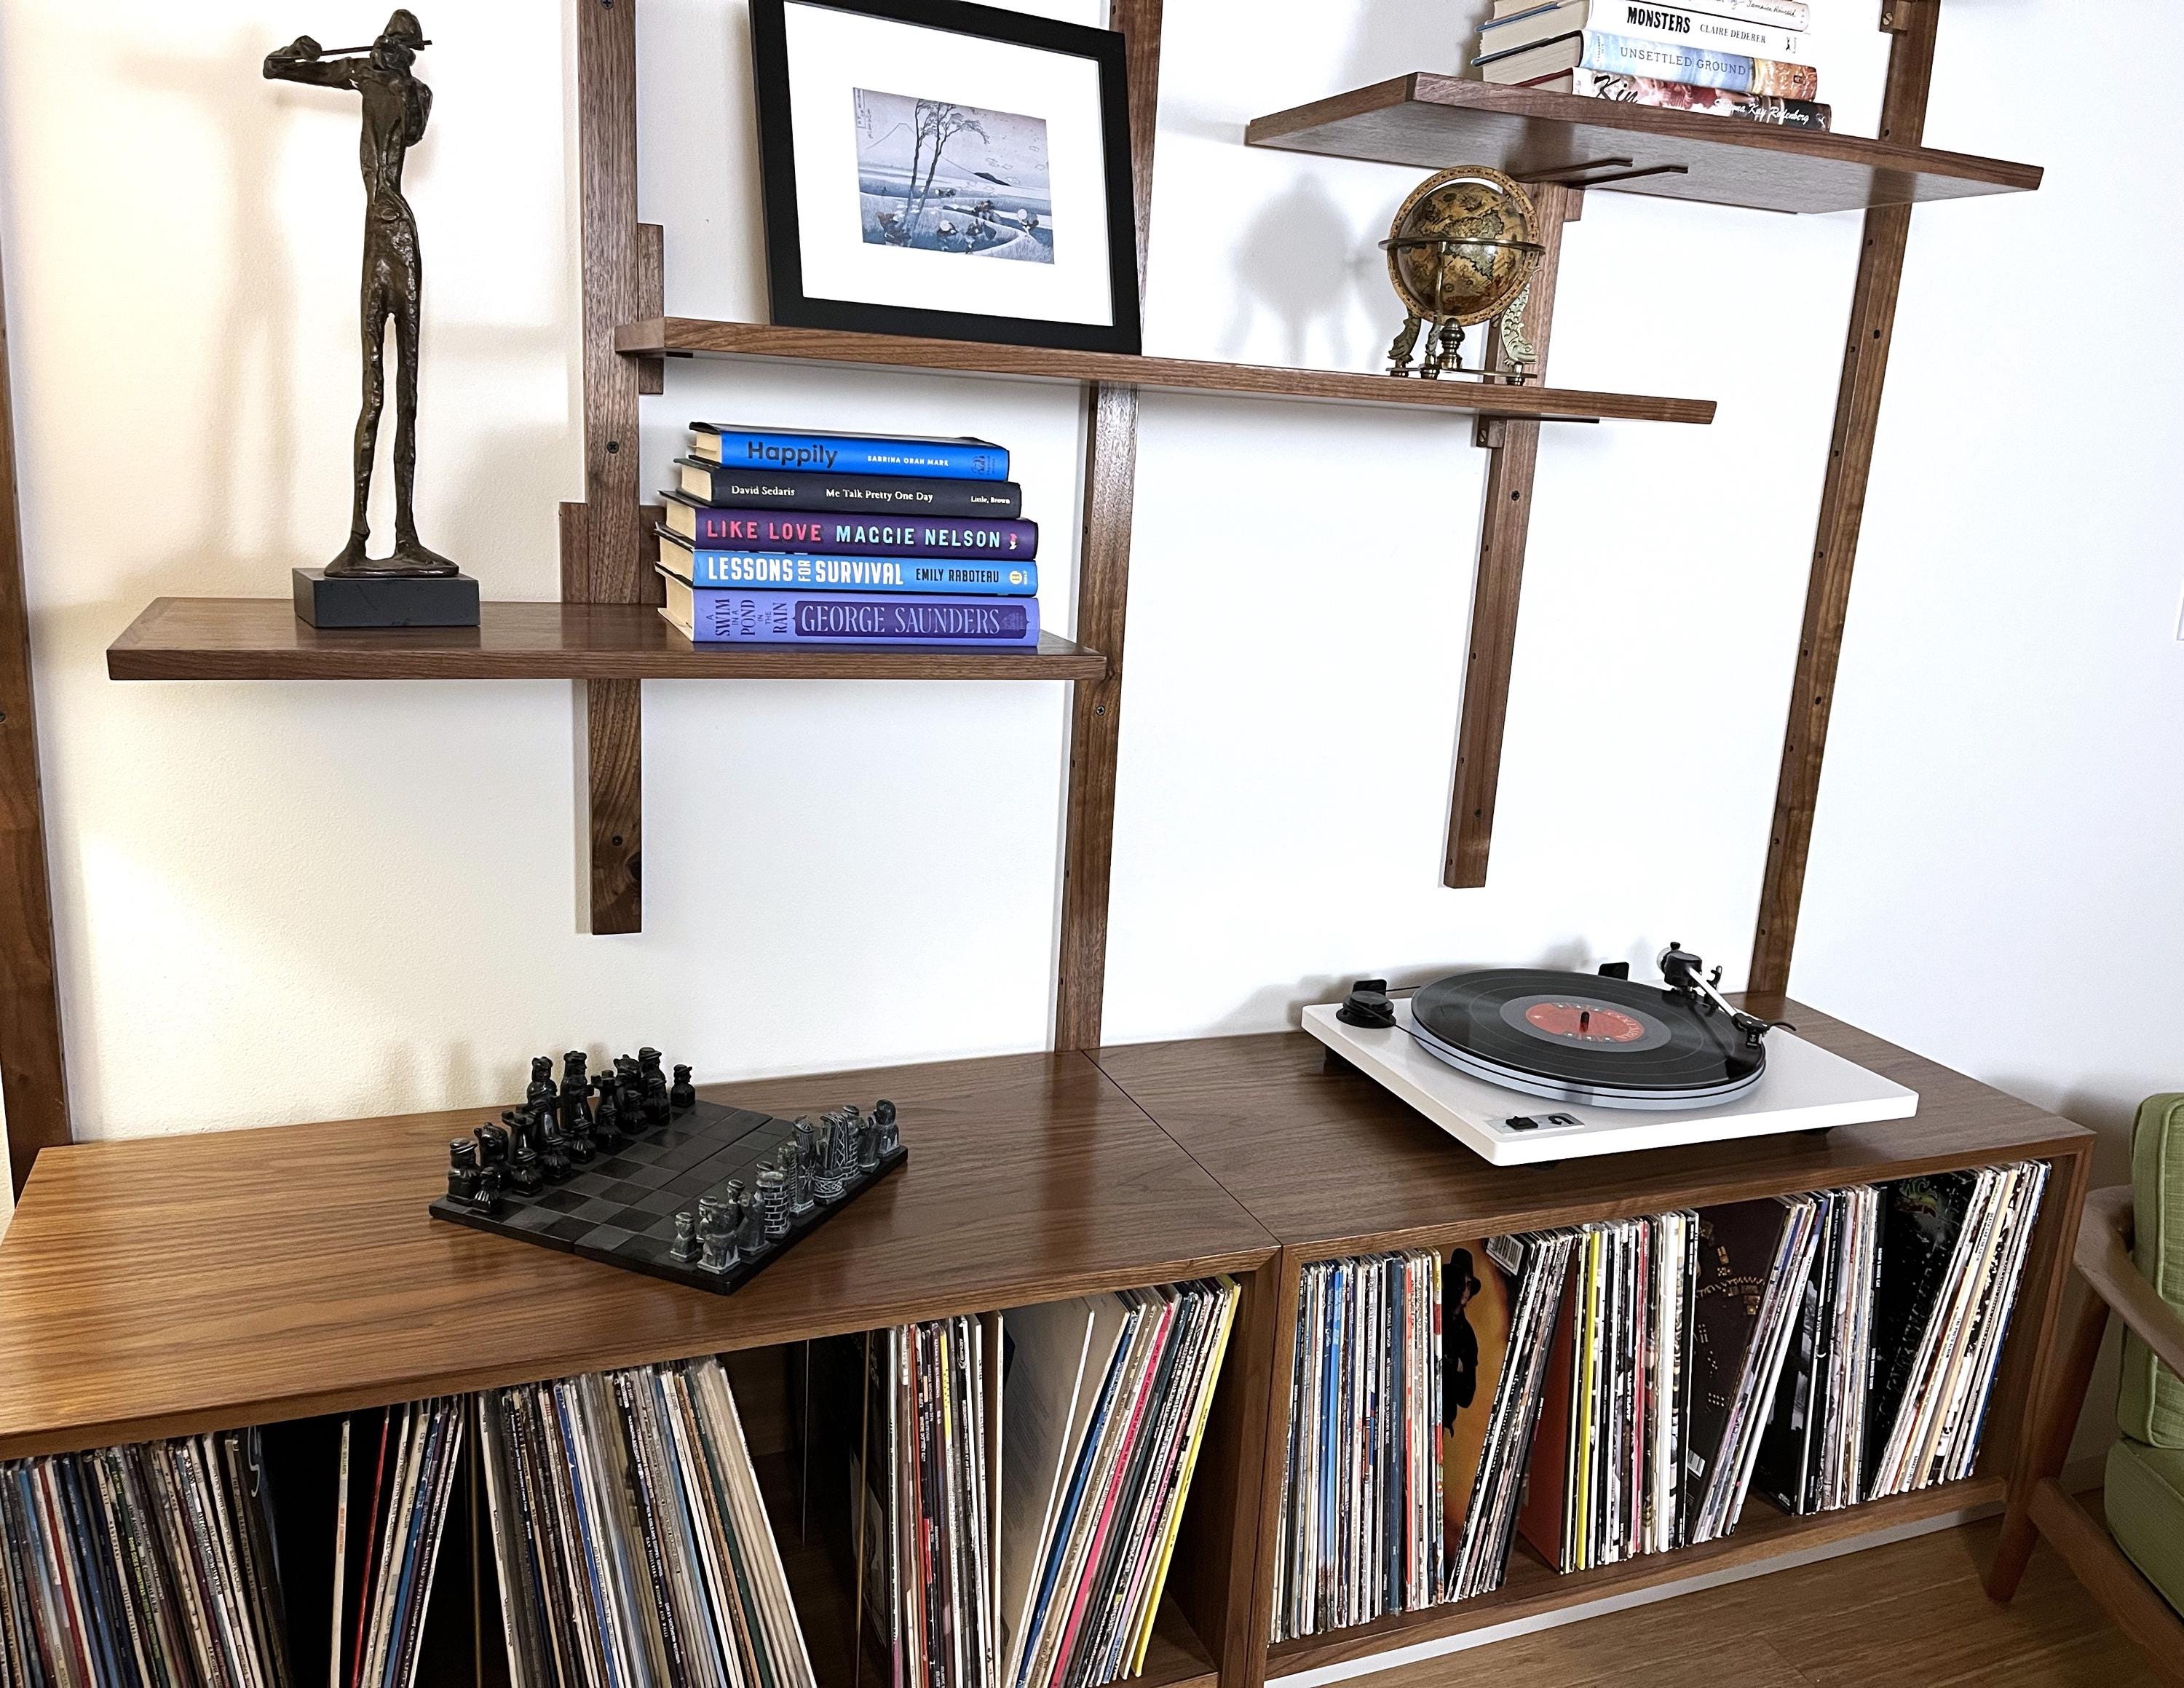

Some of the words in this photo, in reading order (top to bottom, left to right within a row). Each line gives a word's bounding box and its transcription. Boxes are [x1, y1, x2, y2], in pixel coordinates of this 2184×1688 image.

[1627, 6, 1690, 33] MONSTERS
[1700, 23, 1728, 37] CLAIRE
[1730, 30, 1766, 44] DEDERER
[1621, 47, 1693, 67] UNSETTLED
[1696, 59, 1746, 76] GROUND
[748, 440, 837, 469] Happily
[867, 455, 901, 464] SABRINA
[903, 456, 925, 465] ORAH
[927, 459, 949, 467] MARK
[732, 485, 759, 496] David
[761, 486, 795, 496] Sedaris
[826, 488, 840, 498] Me
[843, 488, 863, 499] Talk
[866, 490, 893, 502] Pretty
[895, 490, 914, 501] One
[916, 491, 933, 504] Day
[990, 496, 1010, 504] Brown
[707, 520, 758, 539] LIKE
[769, 522, 821, 542] LOVE
[836, 525, 915, 545] MAGGIE
[925, 528, 1000, 548] NELSON
[708, 556, 793, 582] LESSONS
[797, 560, 812, 582] FOR
[815, 560, 903, 585] SURVIVAL
[916, 568, 944, 582] EMILY
[949, 569, 1000, 583] RABOTEAU
[715, 598, 731, 637] SWIM
[732, 617, 739, 626] IN
[740, 599, 756, 636] POND
[757, 614, 764, 622] IN
[772, 602, 788, 634] RAIN
[802, 604, 885, 633] GEORGE
[895, 606, 1000, 635] SAUNDERS
